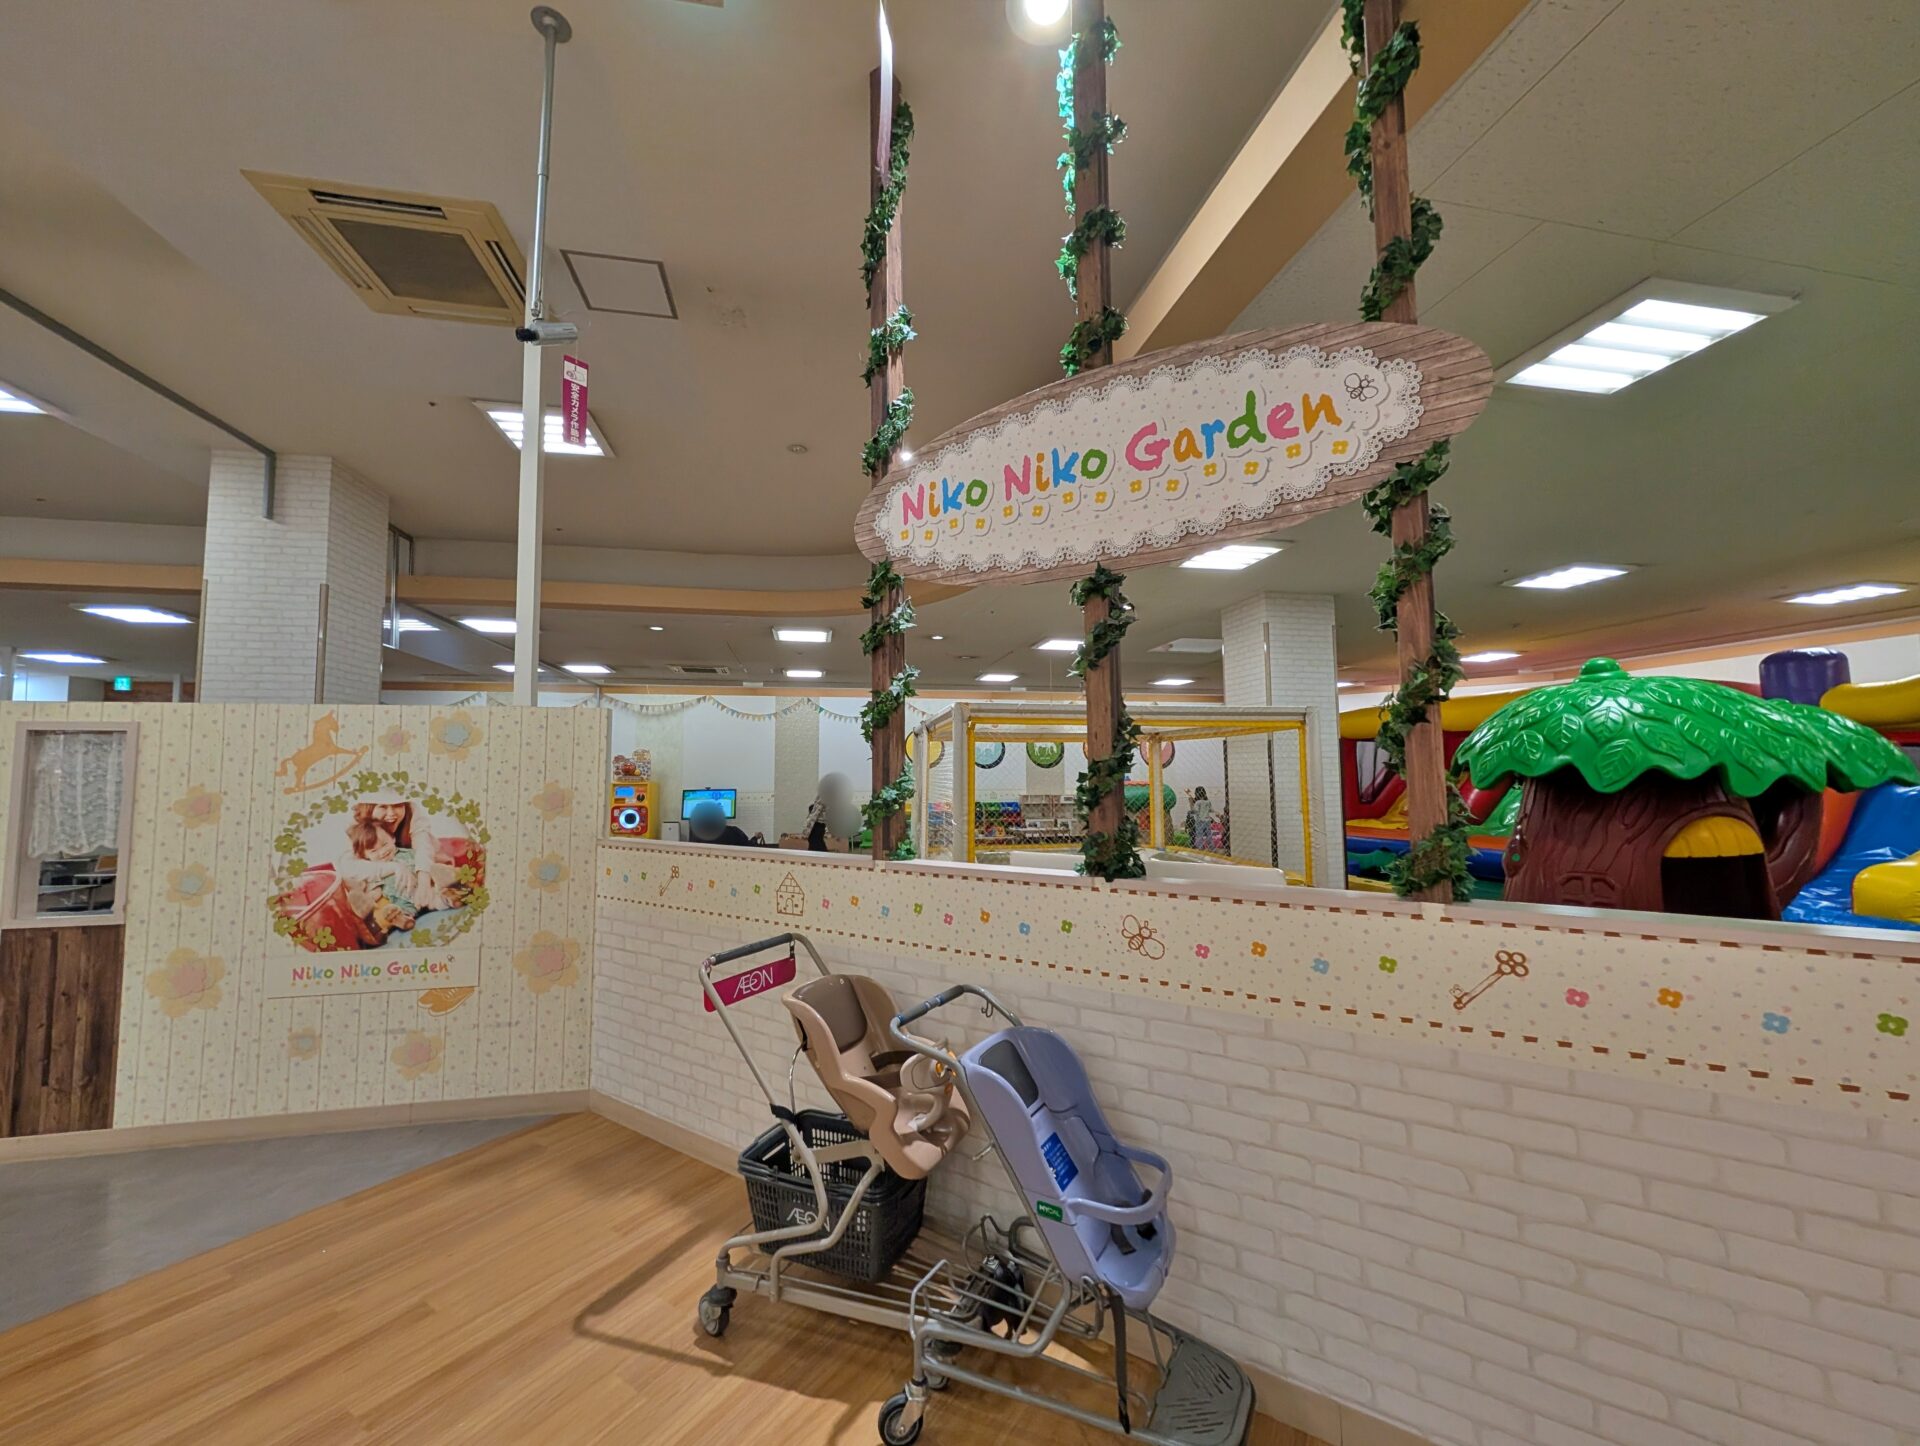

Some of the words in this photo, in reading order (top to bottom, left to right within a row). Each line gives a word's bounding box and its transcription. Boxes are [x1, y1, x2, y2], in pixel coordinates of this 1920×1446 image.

[570, 382, 580, 444] 安全カメラ作動中
[901, 478, 988, 525] Niko
[1004, 448, 1108, 501] Niko
[1124, 390, 1342, 471] Garden
[292, 966, 334, 981] Niko
[340, 965, 381, 977] Niko
[387, 958, 449, 976] Garden
